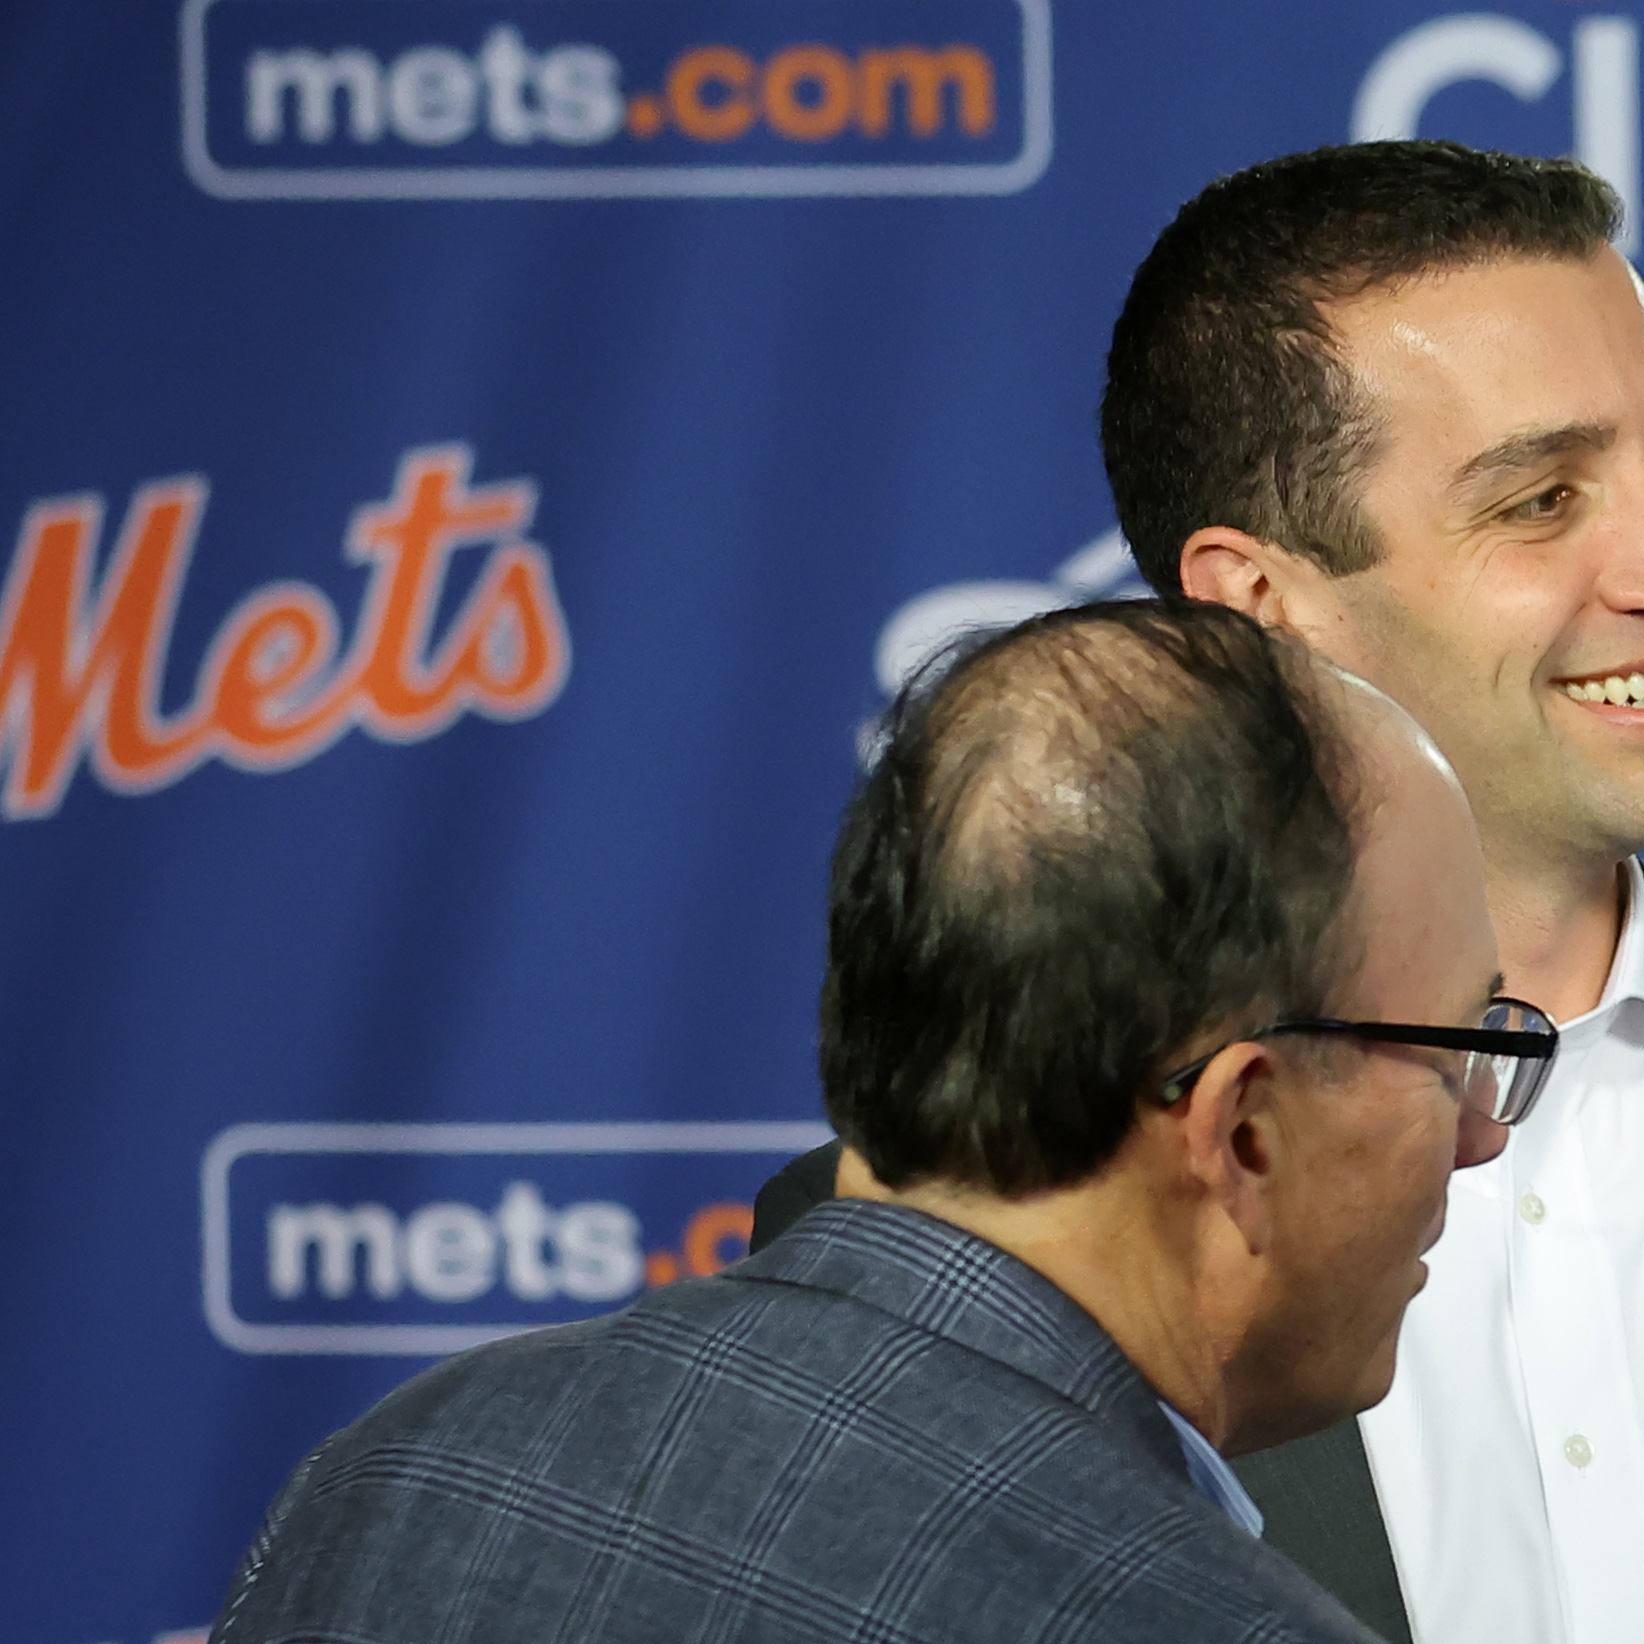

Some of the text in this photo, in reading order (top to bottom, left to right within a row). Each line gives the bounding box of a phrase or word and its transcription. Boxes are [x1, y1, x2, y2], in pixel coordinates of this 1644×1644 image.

[243, 22, 998, 147] mets.com
[0, 442, 572, 821] Mets
[268, 1181, 755, 1303] mets.c
